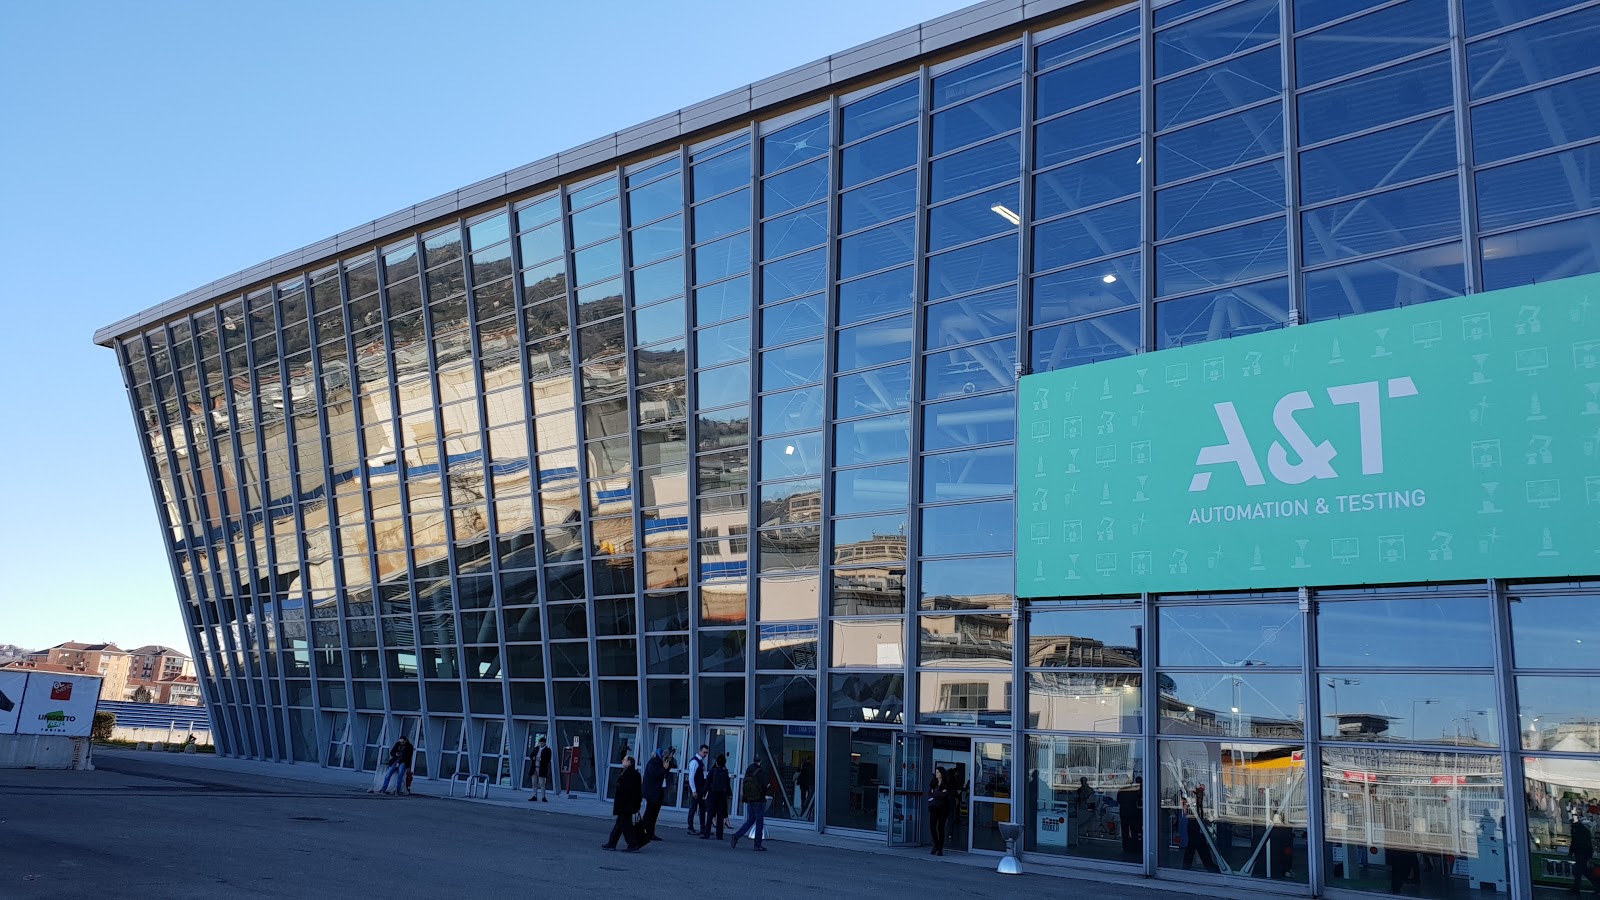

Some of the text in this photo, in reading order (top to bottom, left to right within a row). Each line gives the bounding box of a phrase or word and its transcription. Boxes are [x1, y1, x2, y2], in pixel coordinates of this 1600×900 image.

[1188, 376, 1419, 492] A&T
[1188, 488, 1426, 524] AUTOMATION & TESTING
